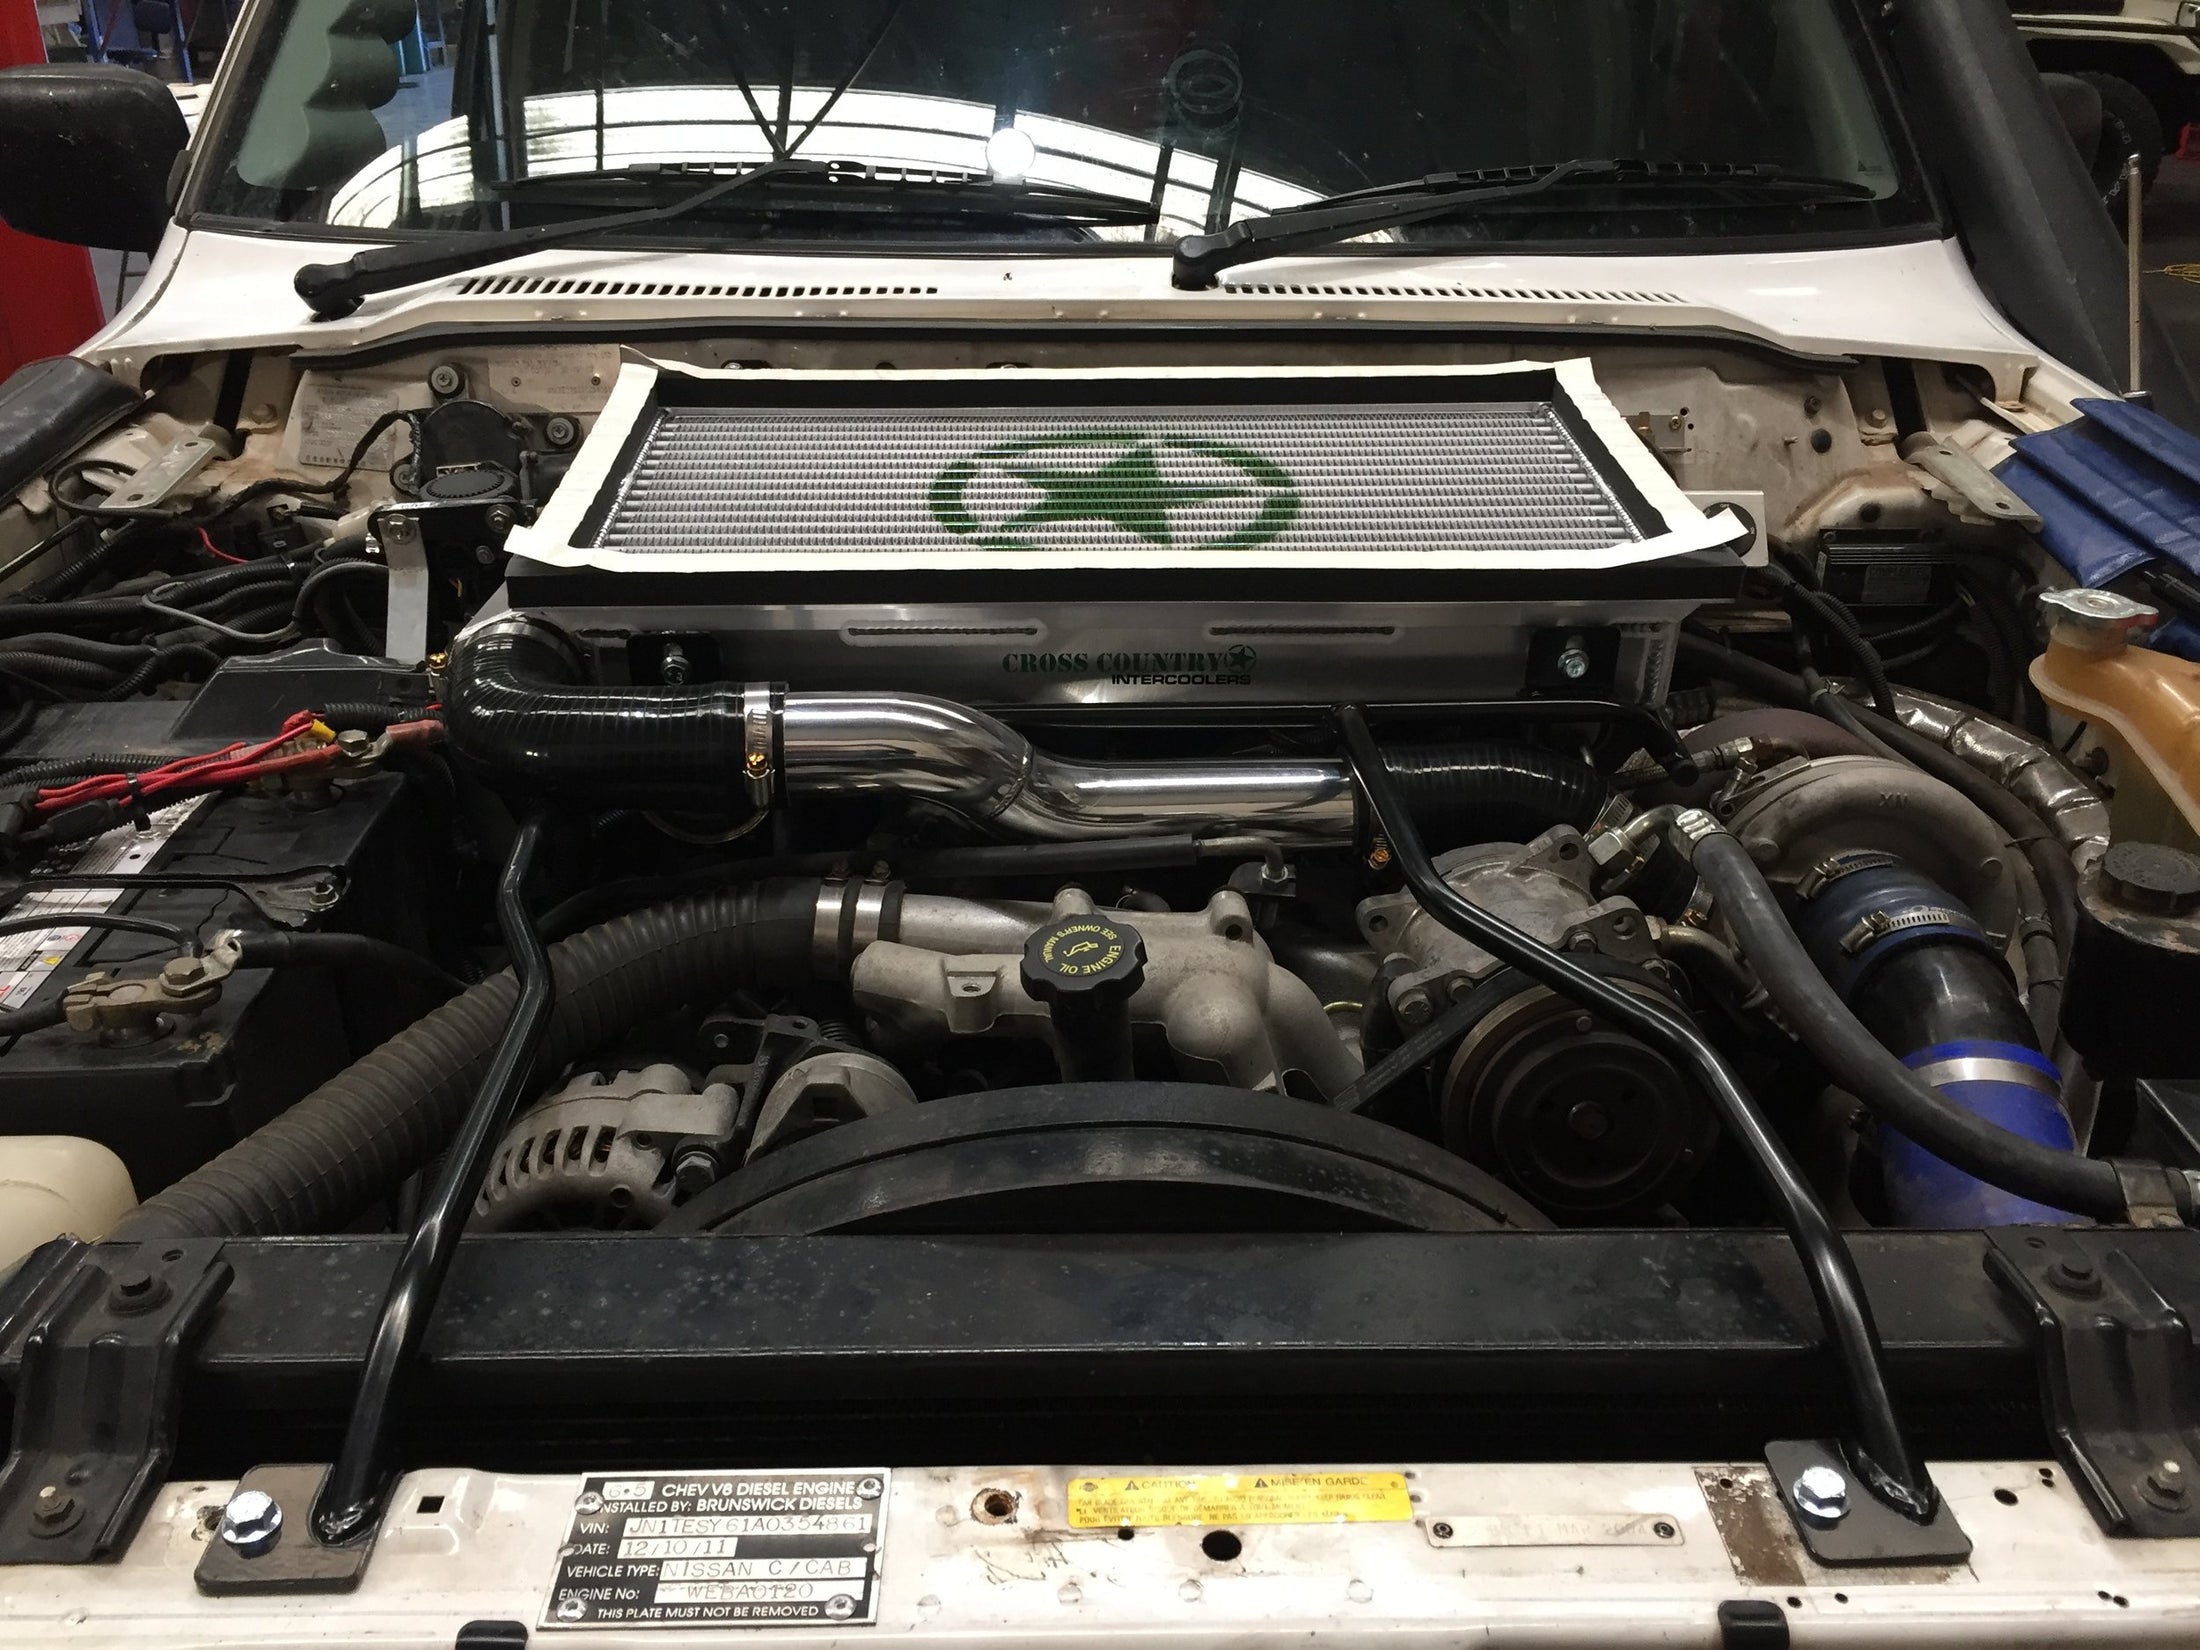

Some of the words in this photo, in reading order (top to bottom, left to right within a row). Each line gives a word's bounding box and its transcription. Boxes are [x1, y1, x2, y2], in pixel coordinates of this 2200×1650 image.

[1002, 652, 1088, 673] CROSS
[1096, 652, 1225, 673] COUNTRY
[1111, 674, 1251, 685] INTERCOOLERS
[1100, 927, 1118, 941] SEE
[1082, 945, 1122, 974] ENGINE
[1059, 962, 1079, 974] OIL
[661, 1483, 709, 1497] CHEV
[712, 1483, 733, 1496] V8
[736, 1482, 790, 1496] DIESEL
[793, 1481, 855, 1495] ENGINE
[600, 1501, 667, 1512] NSTALLED
[696, 1498, 796, 1512] BRUNSWICK
[799, 1497, 863, 1510] DIESELS
[580, 1523, 610, 1534] VIN:
[567, 1565, 624, 1578] VEHICLE
[626, 1564, 660, 1577] TYPE:
[664, 1561, 753, 1577] NISSAN
[558, 1588, 612, 1601] ENGINE
[597, 1609, 623, 1619] THIS
[625, 1609, 662, 1618] PLATE
[664, 1607, 700, 1618] MUST
[702, 1607, 731, 1617] NOT
[733, 1607, 749, 1617] BE
[751, 1606, 819, 1616] REMOVED
